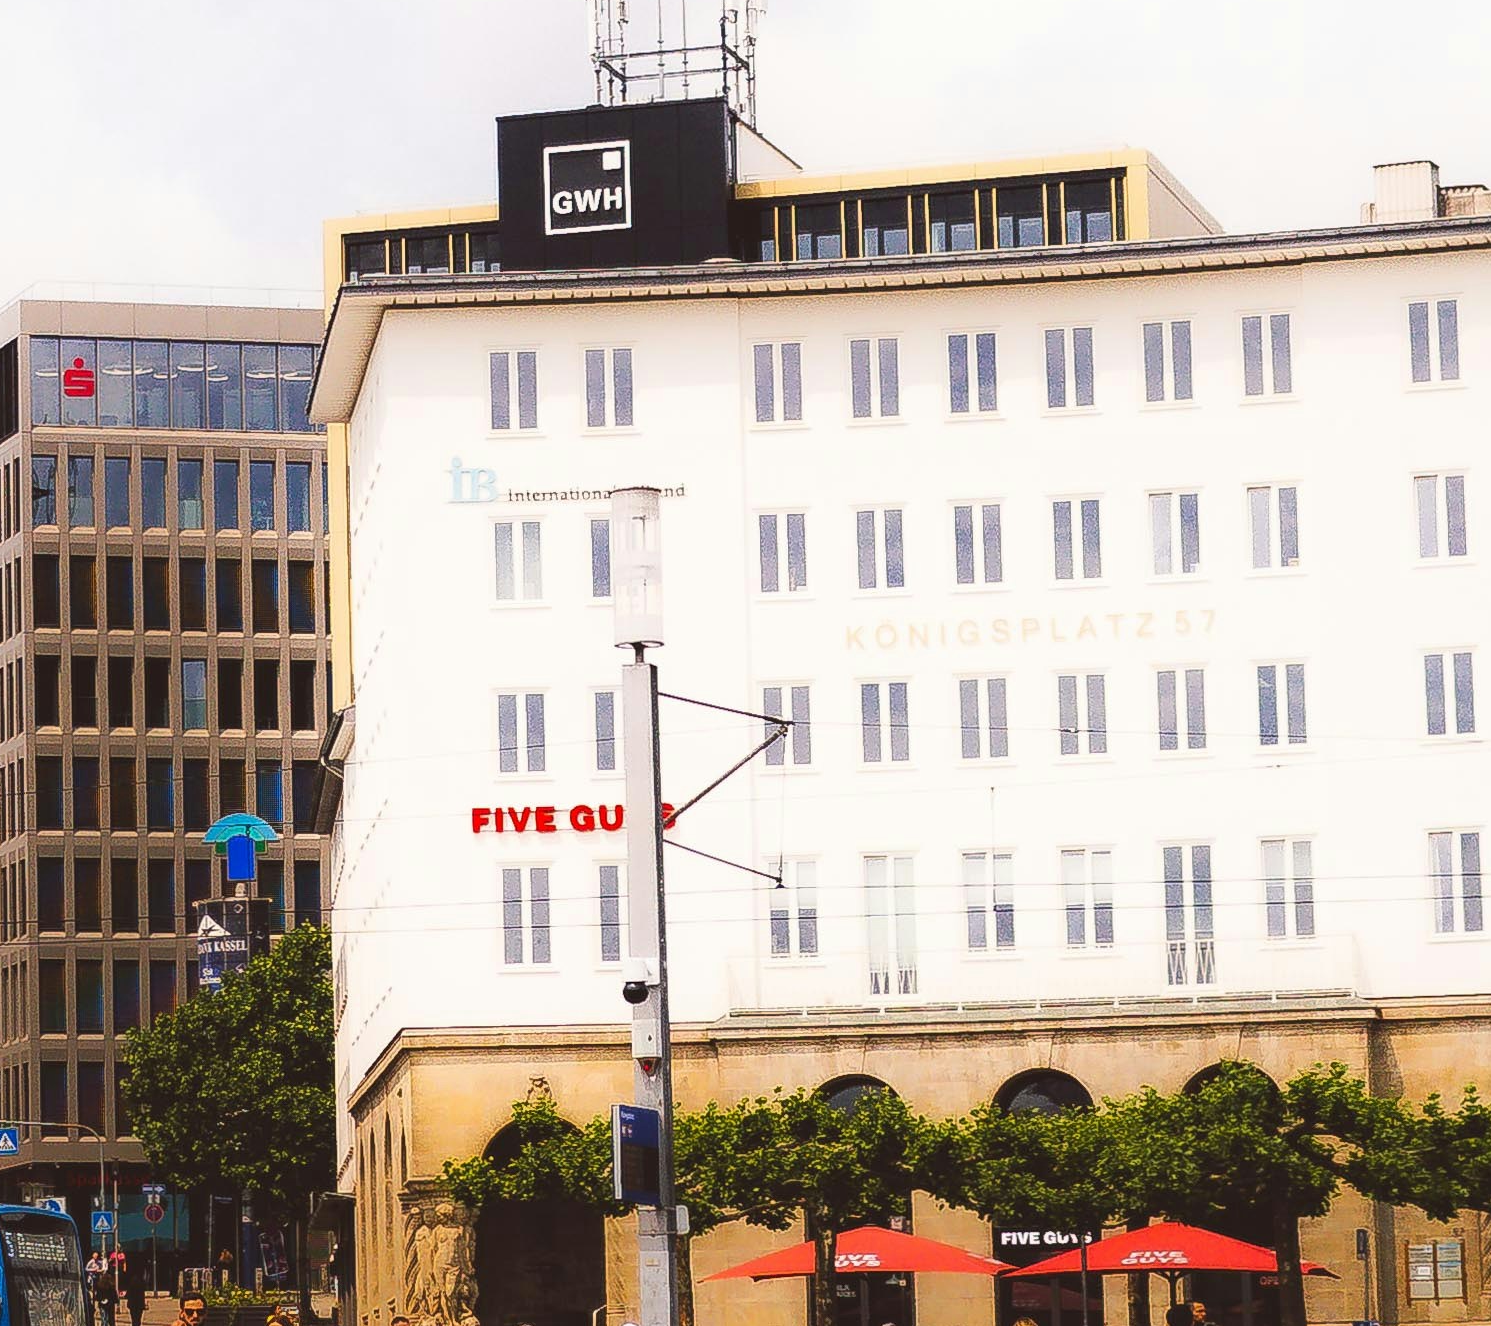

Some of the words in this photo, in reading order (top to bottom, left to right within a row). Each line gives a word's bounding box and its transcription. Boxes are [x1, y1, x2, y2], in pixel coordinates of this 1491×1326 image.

[552, 186, 623, 215] GWH
[845, 610, 1155, 651] KÖNIGSPLATZ
[1174, 608, 1216, 638] 57
[471, 806, 558, 834] FIVE
[214, 939, 248, 952] KASSEL
[1001, 1231, 1041, 1246] FIVE
[1120, 1257, 1190, 1265] GUYS
[1128, 1250, 1185, 1258] FIVE
